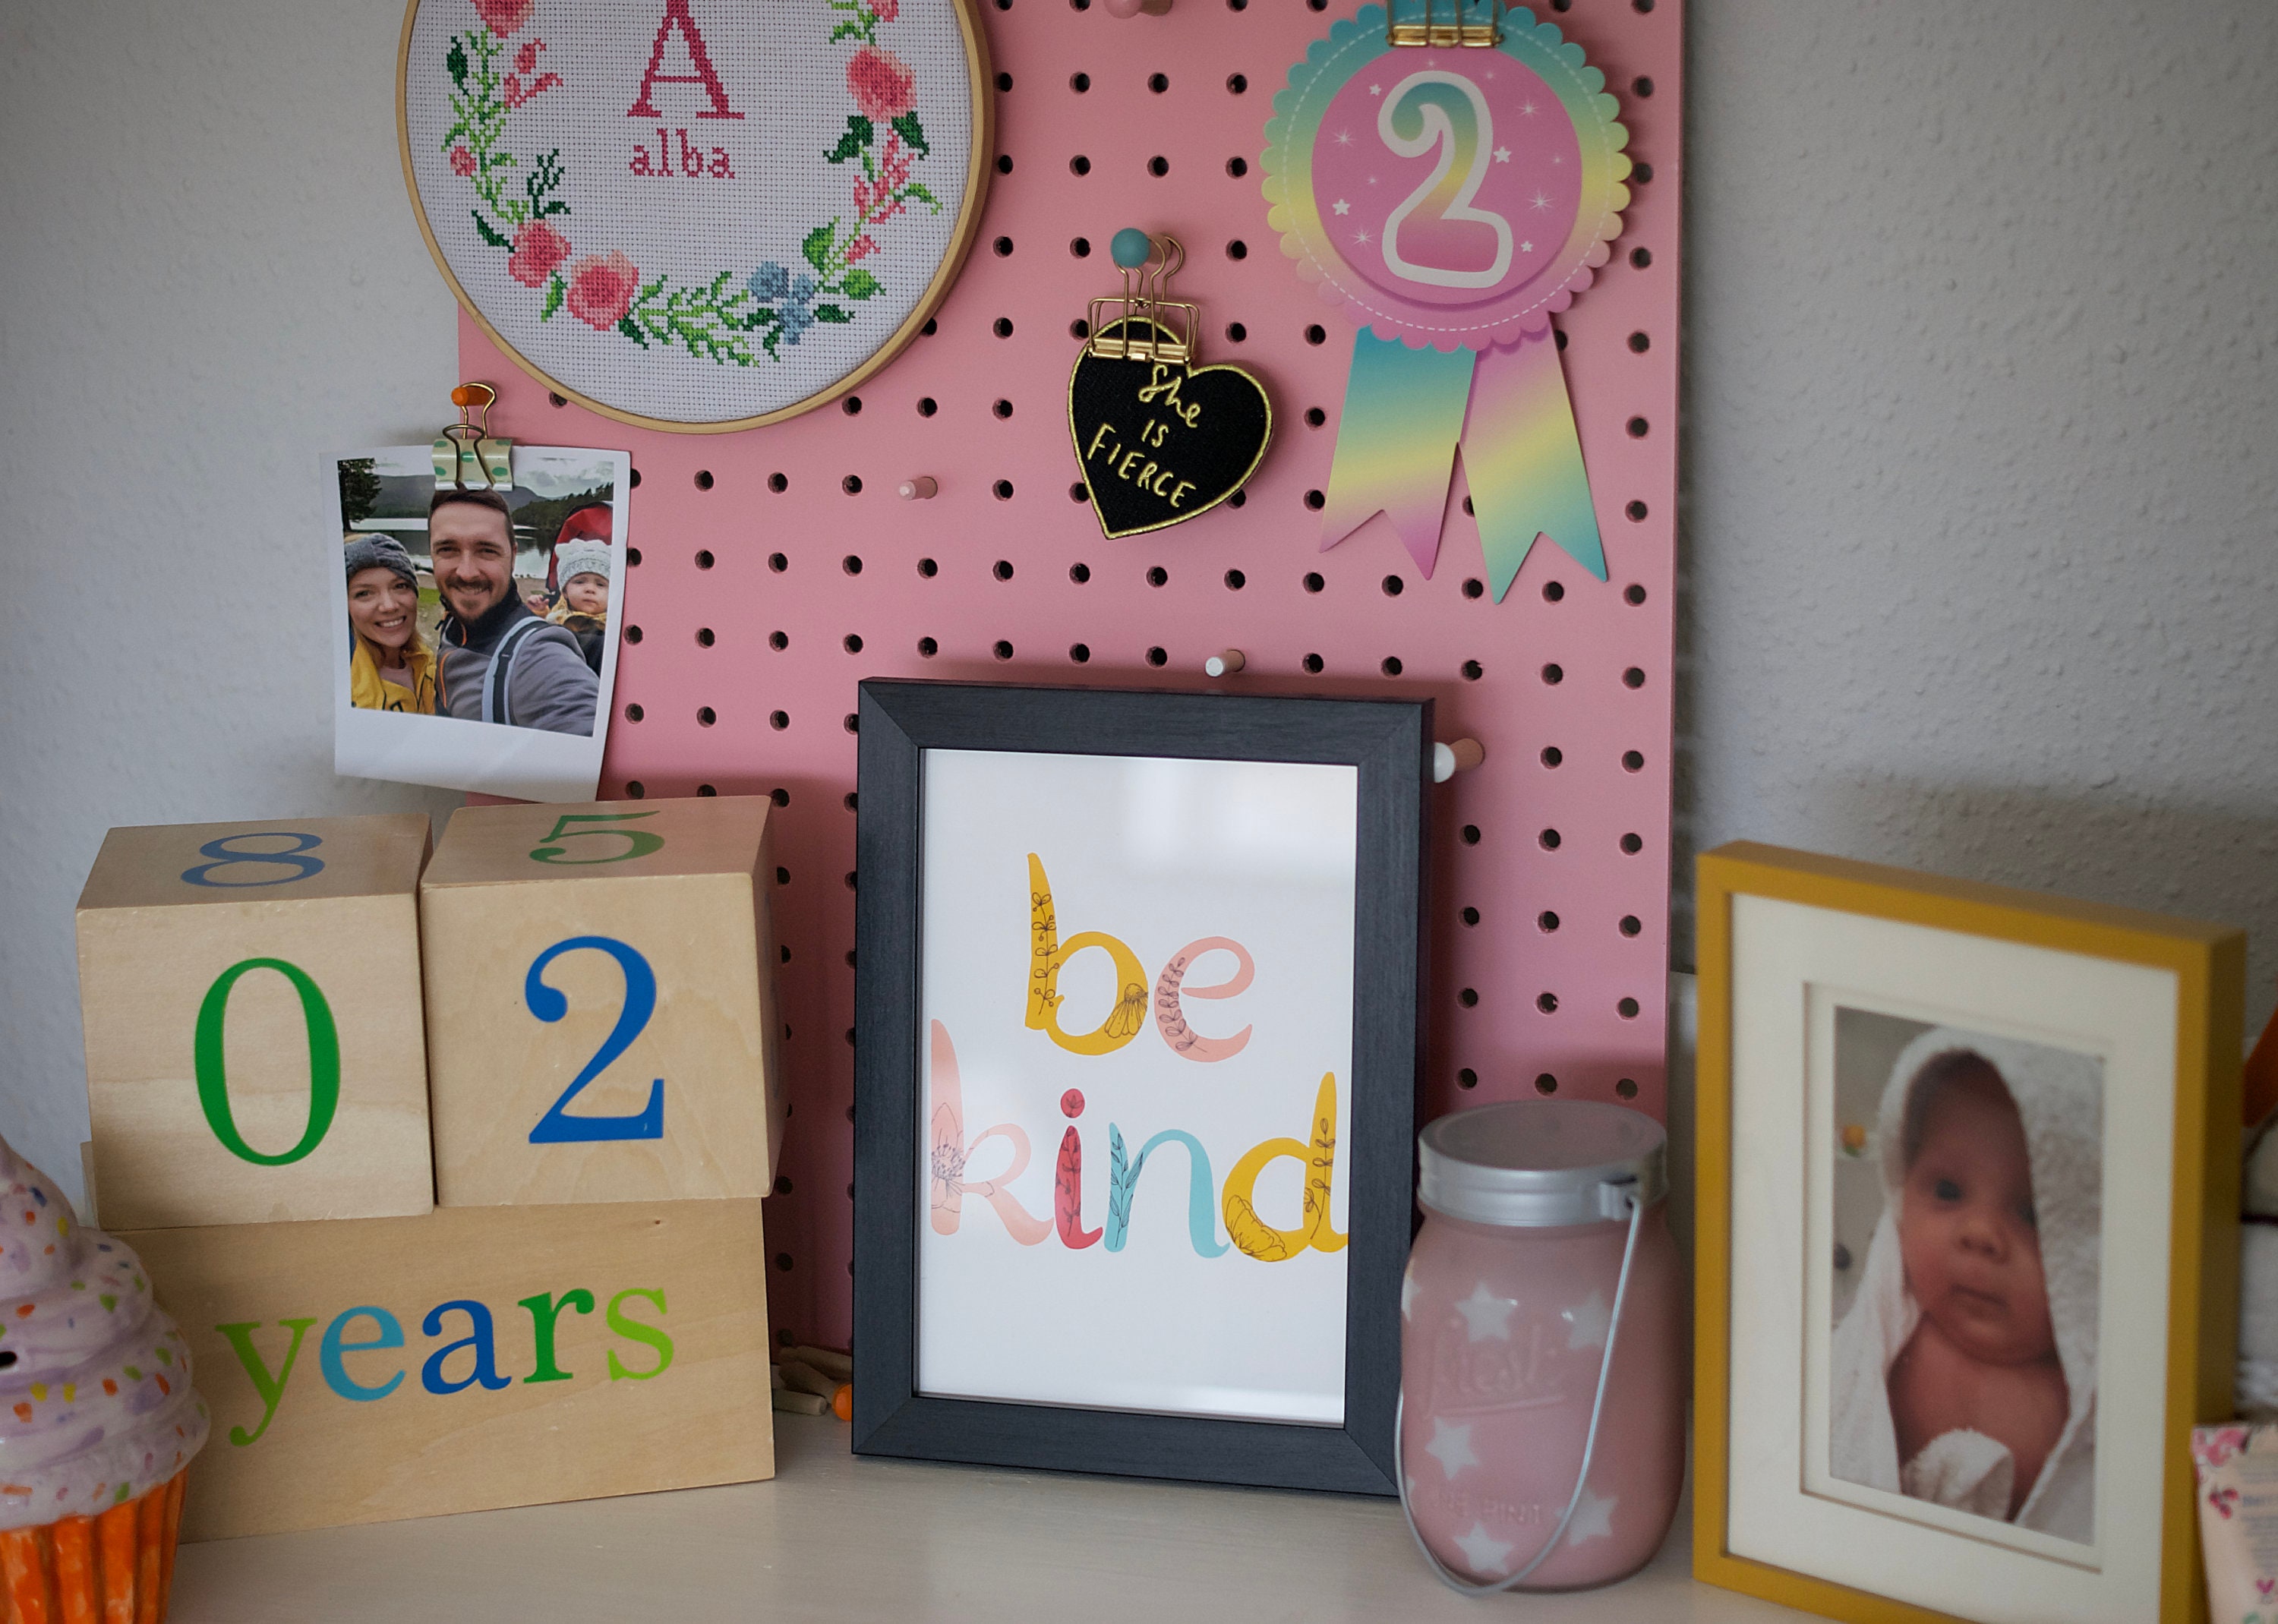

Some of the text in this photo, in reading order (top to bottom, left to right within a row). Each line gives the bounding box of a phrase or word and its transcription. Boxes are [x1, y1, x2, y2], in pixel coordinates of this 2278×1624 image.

[627, 0, 745, 119] A
[629, 128, 735, 179] alba
[1377, 70, 1513, 289] 2
[1137, 364, 1201, 428] She
[1141, 419, 1169, 448] IS
[1087, 422, 1197, 508] FIERCE
[181, 810, 666, 888] 8 5
[1024, 852, 1255, 1063] be
[930, 1017, 1350, 1263] kind
[215, 1288, 675, 1447] years
